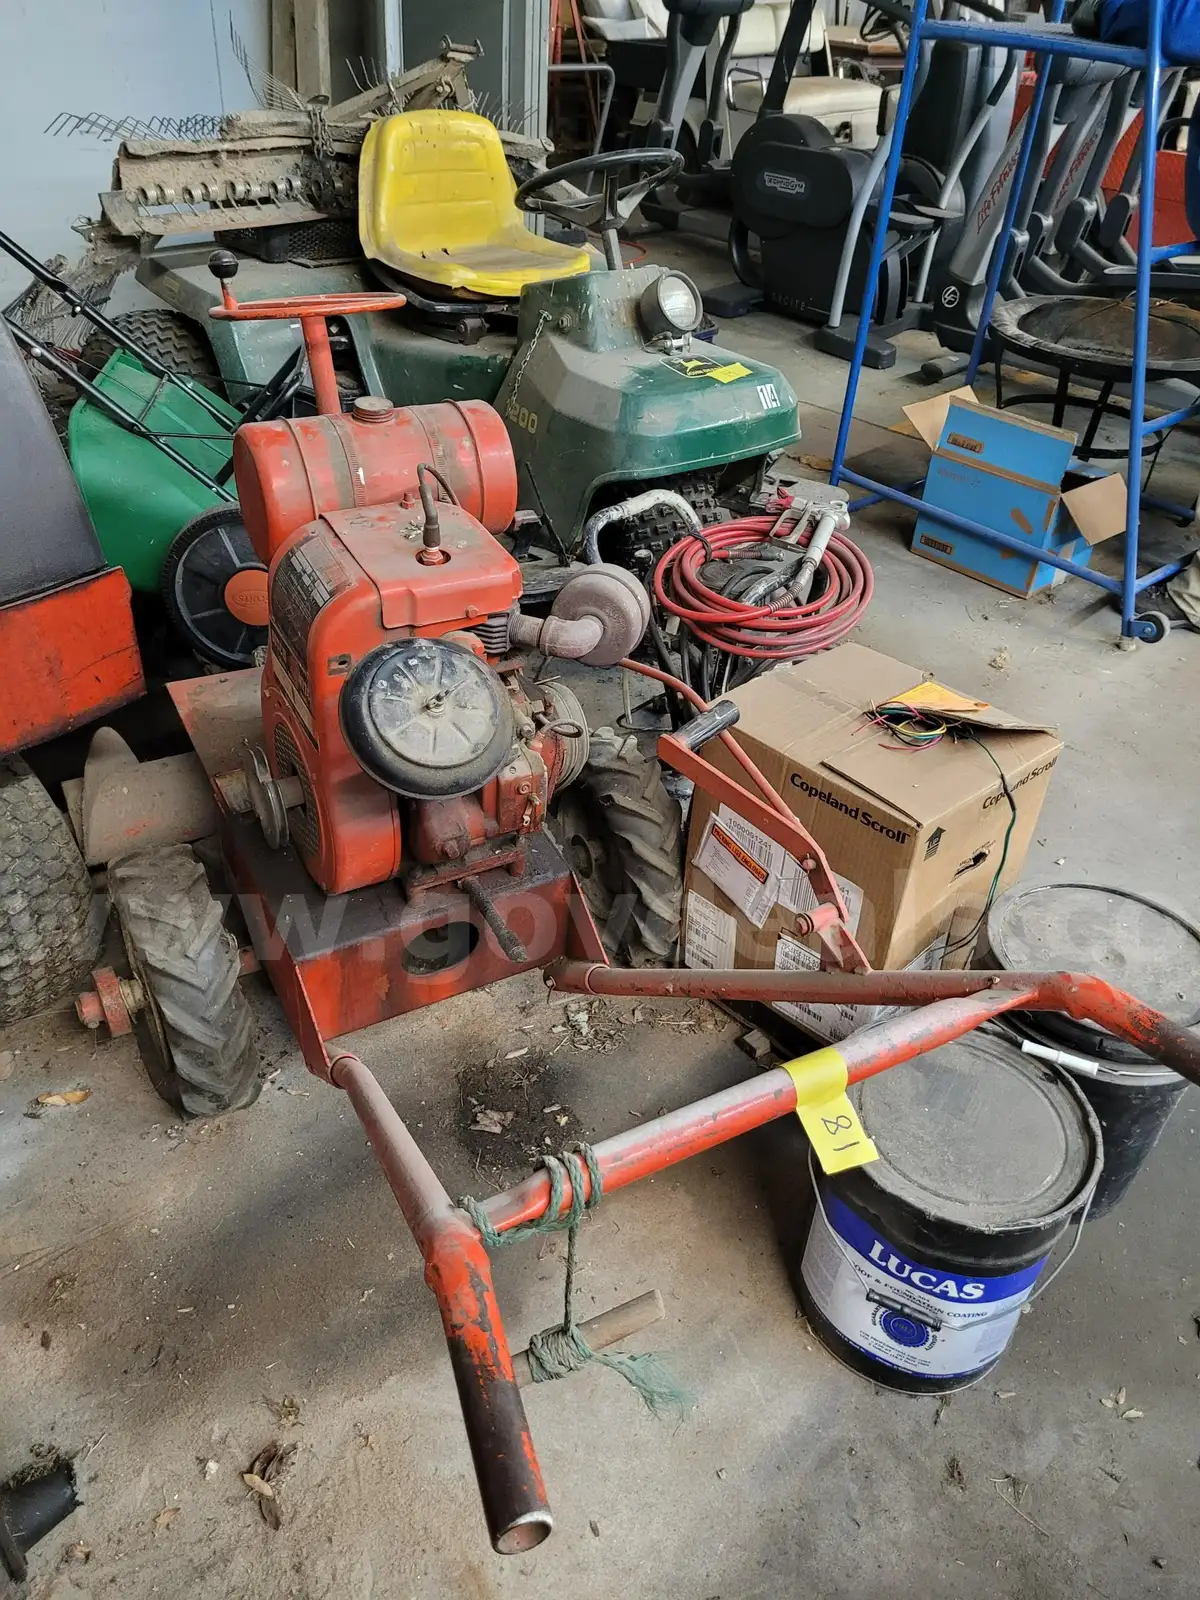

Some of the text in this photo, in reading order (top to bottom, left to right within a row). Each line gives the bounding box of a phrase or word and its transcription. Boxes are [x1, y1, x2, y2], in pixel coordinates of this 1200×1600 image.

[1029, 755, 1058, 780] Scroll
[790, 773, 911, 844] Copeland Scroll
[714, 828, 732, 850] PACKING
[742, 855, 765, 878] ENCLOSED
[869, 1240, 985, 1299] LUCAS
